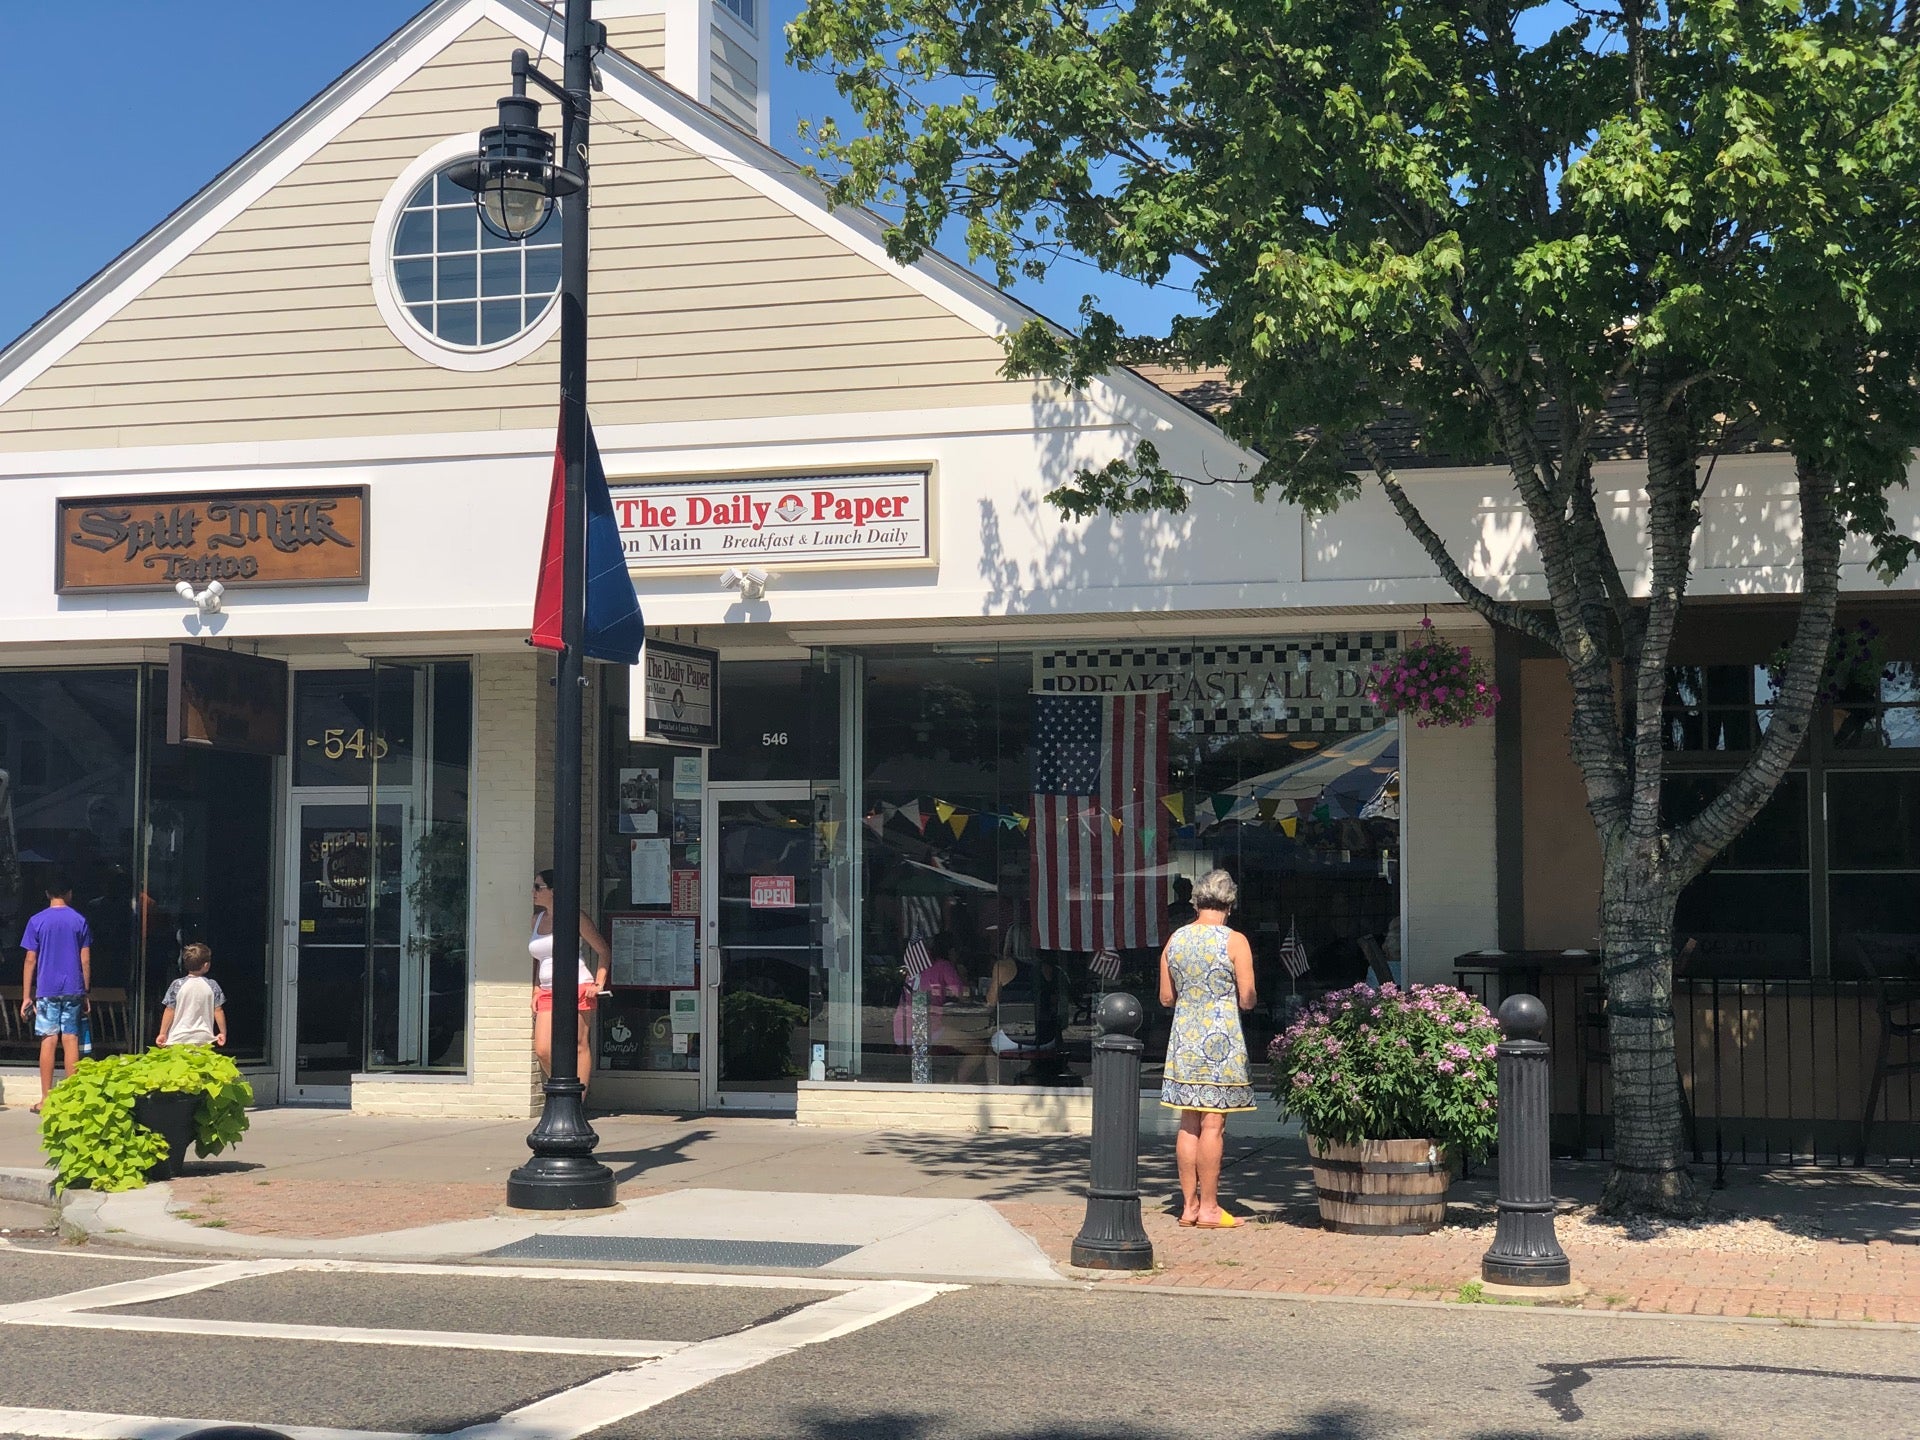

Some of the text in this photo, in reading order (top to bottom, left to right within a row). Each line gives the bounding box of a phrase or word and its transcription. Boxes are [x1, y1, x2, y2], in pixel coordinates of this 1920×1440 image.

[616, 491, 909, 530] The Daily Paper
[70, 500, 355, 562] Spilt Milk
[649, 534, 702, 552] Main
[722, 527, 909, 552] Breakfast & Lunch Daily
[144, 553, 258, 581] Tattoo
[646, 657, 709, 690] The Daily Paper
[1257, 670, 1322, 700] ALL
[1336, 669, 1381, 698] DA
[762, 732, 788, 746] 546
[755, 888, 791, 905] OPEN
[604, 1042, 638, 1054] Oomph!
